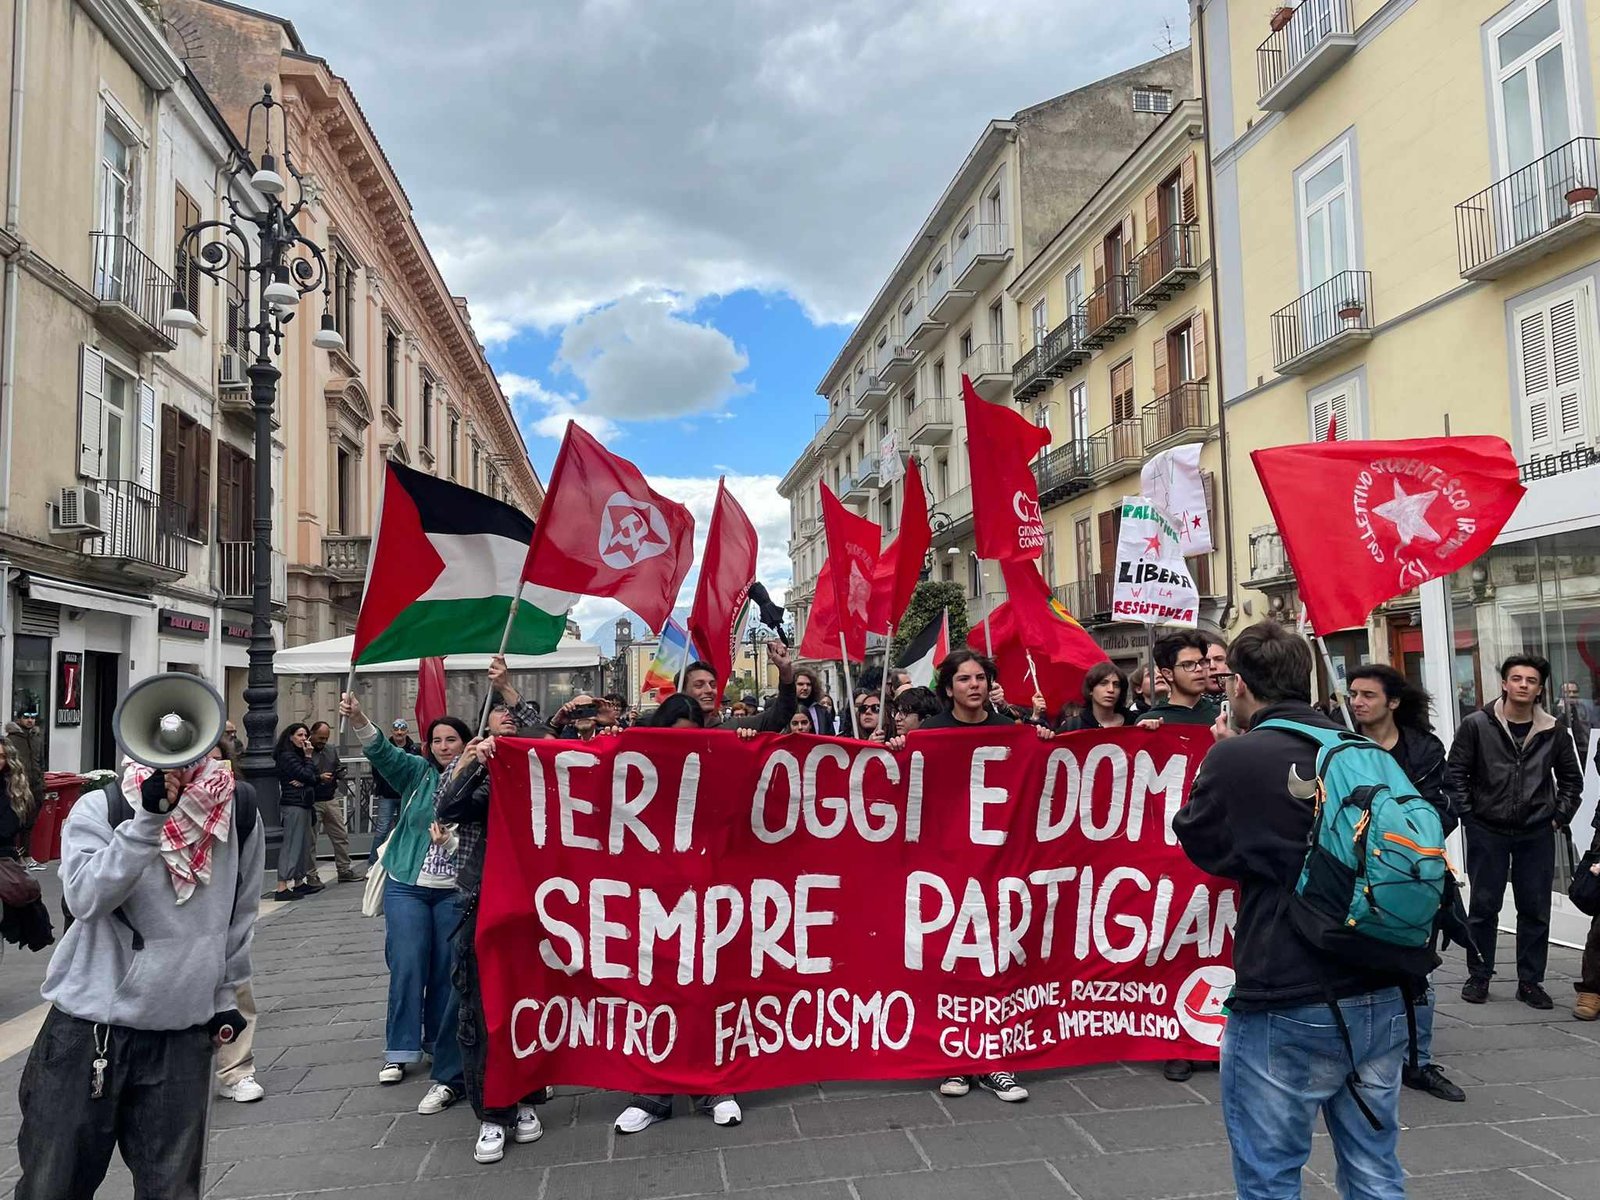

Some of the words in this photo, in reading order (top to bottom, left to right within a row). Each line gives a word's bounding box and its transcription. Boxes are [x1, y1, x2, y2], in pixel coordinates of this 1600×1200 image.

[751, 744, 925, 845] OGGI
[969, 746, 1011, 845] E
[534, 874, 841, 985] SEMPRE
[510, 996, 678, 1064] CONTRO
[714, 988, 915, 1066] FASCISMO
[937, 981, 1067, 1025] REPRESSIONE,
[1071, 979, 1168, 1006] RAZZISMO
[939, 1019, 1037, 1060] GUERRE
[1058, 1009, 1180, 1041] IMPERIALISMO
